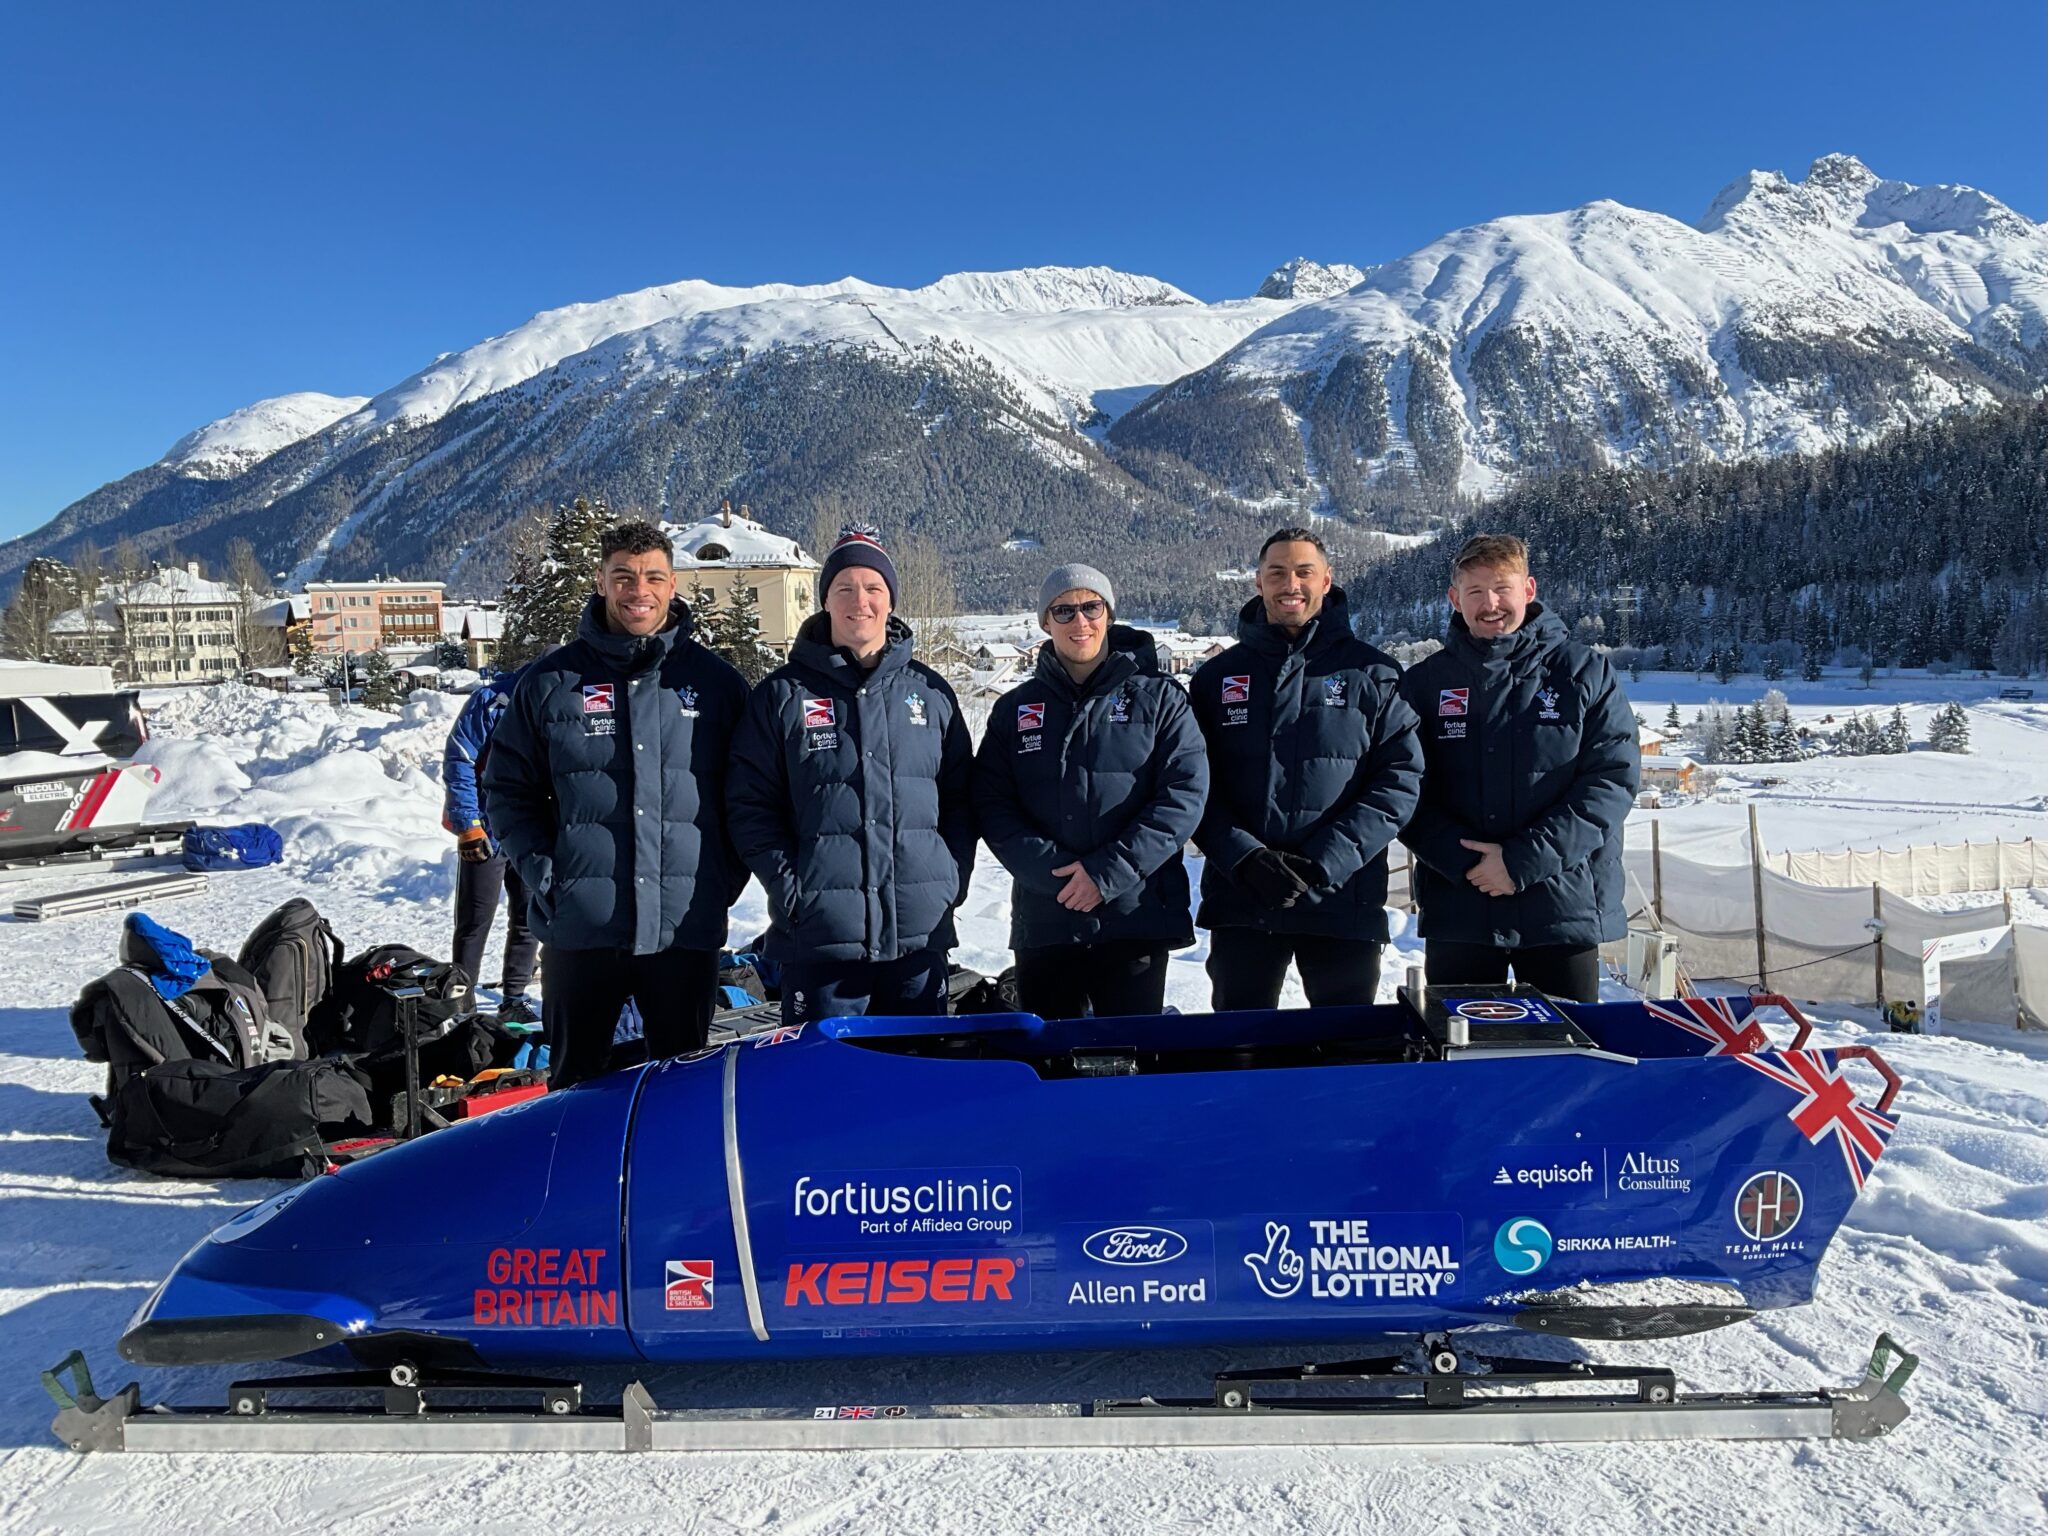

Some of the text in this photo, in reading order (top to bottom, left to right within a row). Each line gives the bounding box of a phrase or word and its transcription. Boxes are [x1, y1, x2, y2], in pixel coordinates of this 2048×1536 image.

[17, 783, 63, 794] LINCOLN
[29, 792, 68, 800] ELECTRIC
[55, 779, 94, 831] USA
[1619, 1152, 1680, 1174] Altus
[1517, 1161, 1593, 1189] equisoft
[1618, 1176, 1691, 1193] Consulting
[794, 1176, 1012, 1216] fortiusclinic
[861, 1217, 1012, 1234] Part of Affidea Group
[1309, 1220, 1369, 1244] THE
[1103, 1231, 1167, 1259] Ford
[1557, 1238, 1612, 1251] SIRKKA
[1726, 1241, 1804, 1254] TEAM HALL
[1742, 1252, 1785, 1260] BOBSLEIGH
[487, 1248, 606, 1285] GREAT
[1310, 1246, 1459, 1271] NATIONAL
[1068, 1278, 1206, 1304] Allen Ford
[473, 1289, 616, 1325] BRITAIN
[815, 1409, 832, 1417] 21
